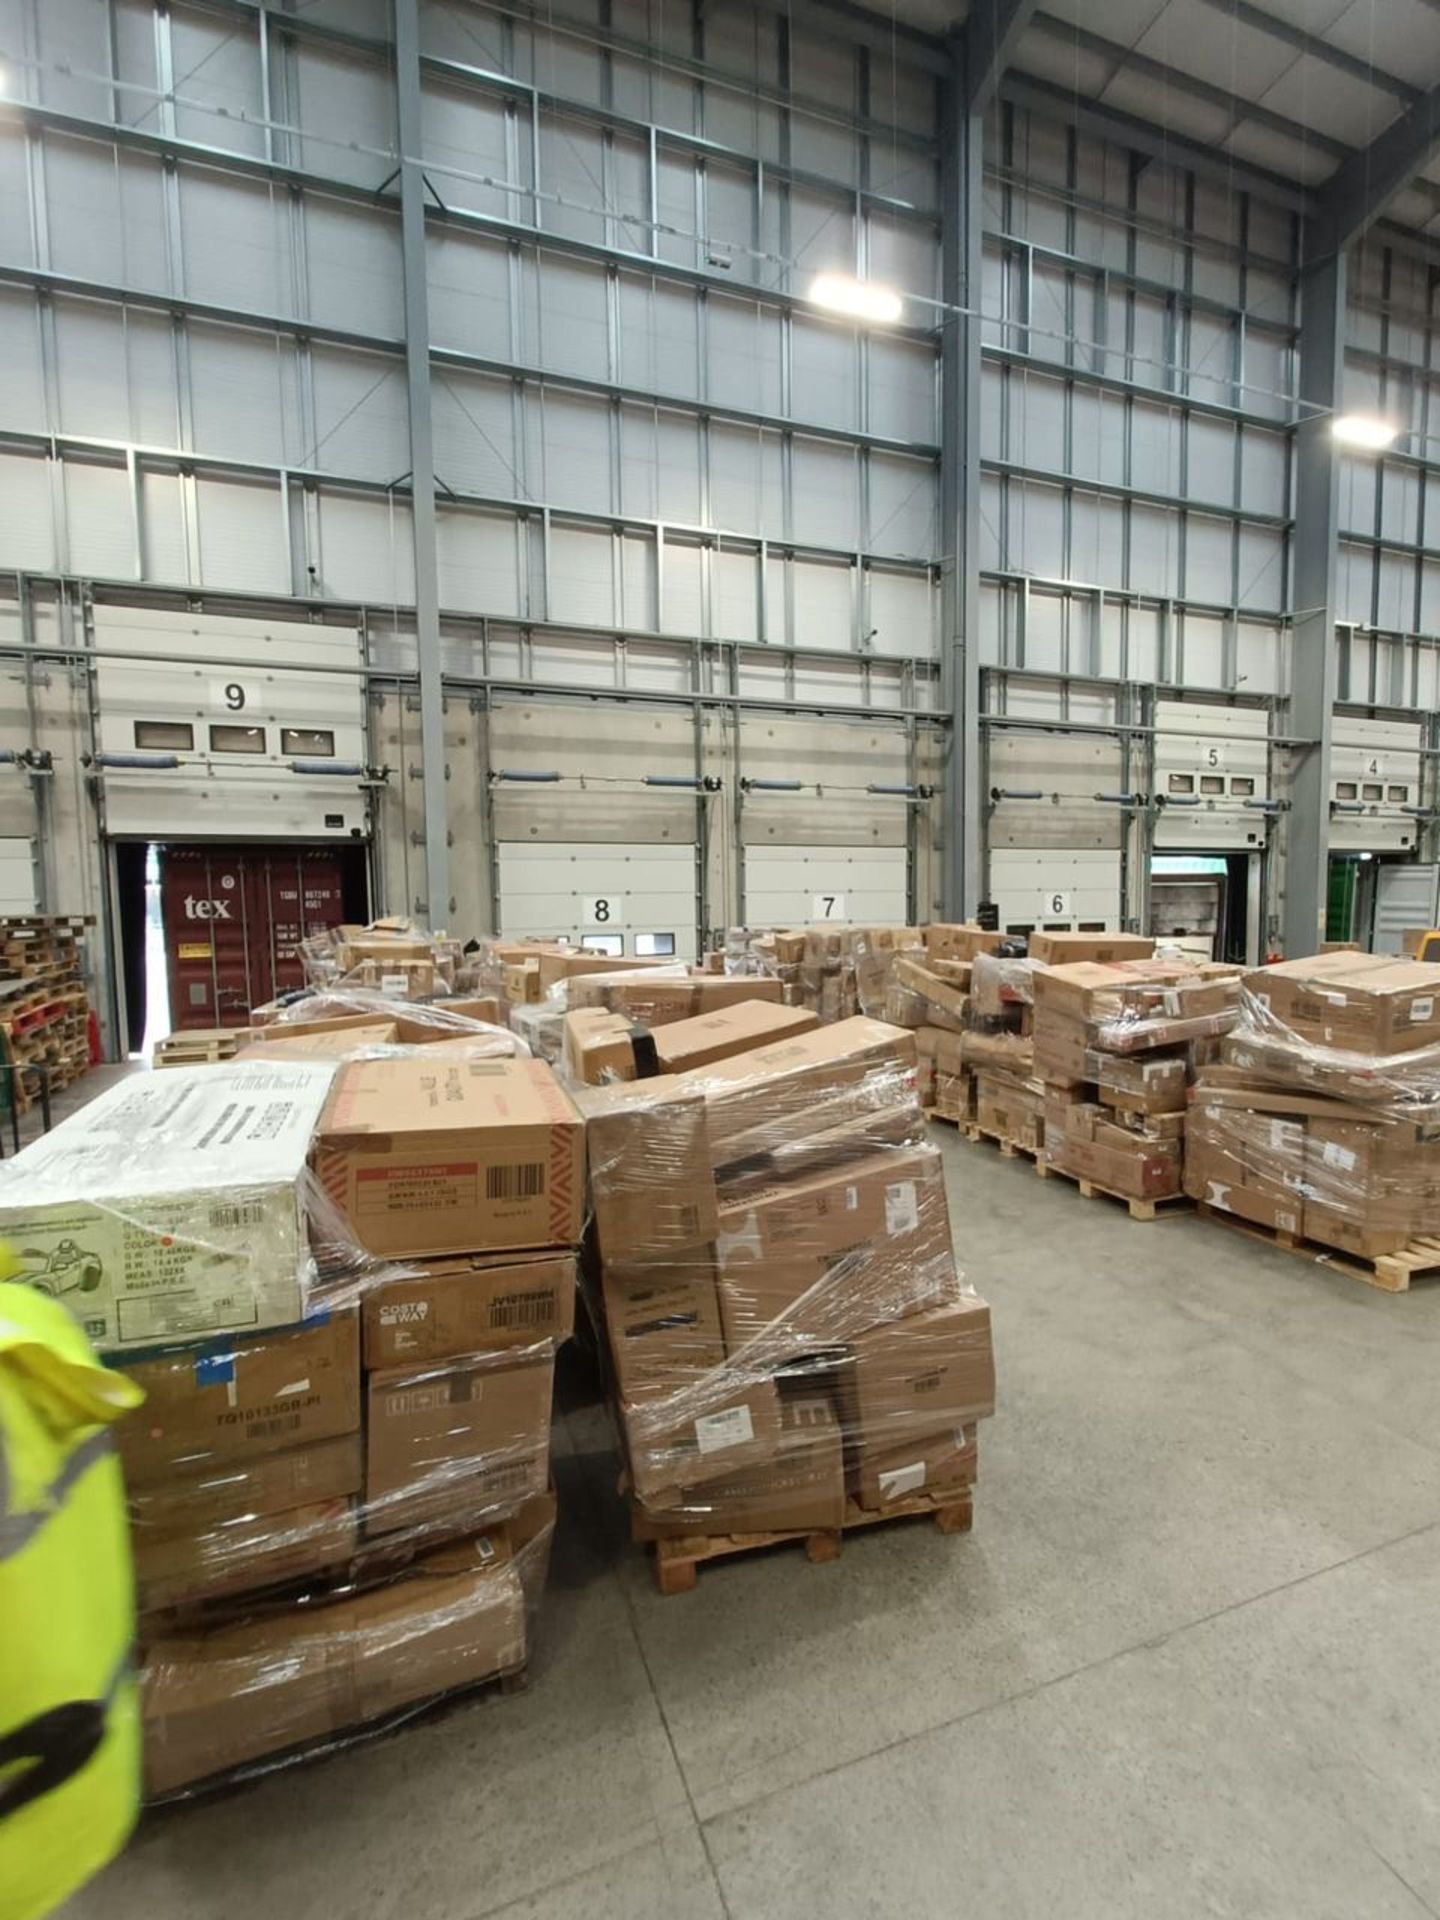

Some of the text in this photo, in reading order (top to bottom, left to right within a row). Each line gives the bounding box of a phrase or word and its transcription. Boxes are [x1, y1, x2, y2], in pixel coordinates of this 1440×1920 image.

[225, 683, 245, 710] 9
[1209, 749, 1218, 767] 5
[1369, 759, 1378, 775] 4
[184, 895, 231, 919] tex
[594, 899, 610, 922] 8
[822, 897, 836, 918] 7
[1052, 895, 1064, 913] 6
[399, 1312, 427, 1323] WAY
